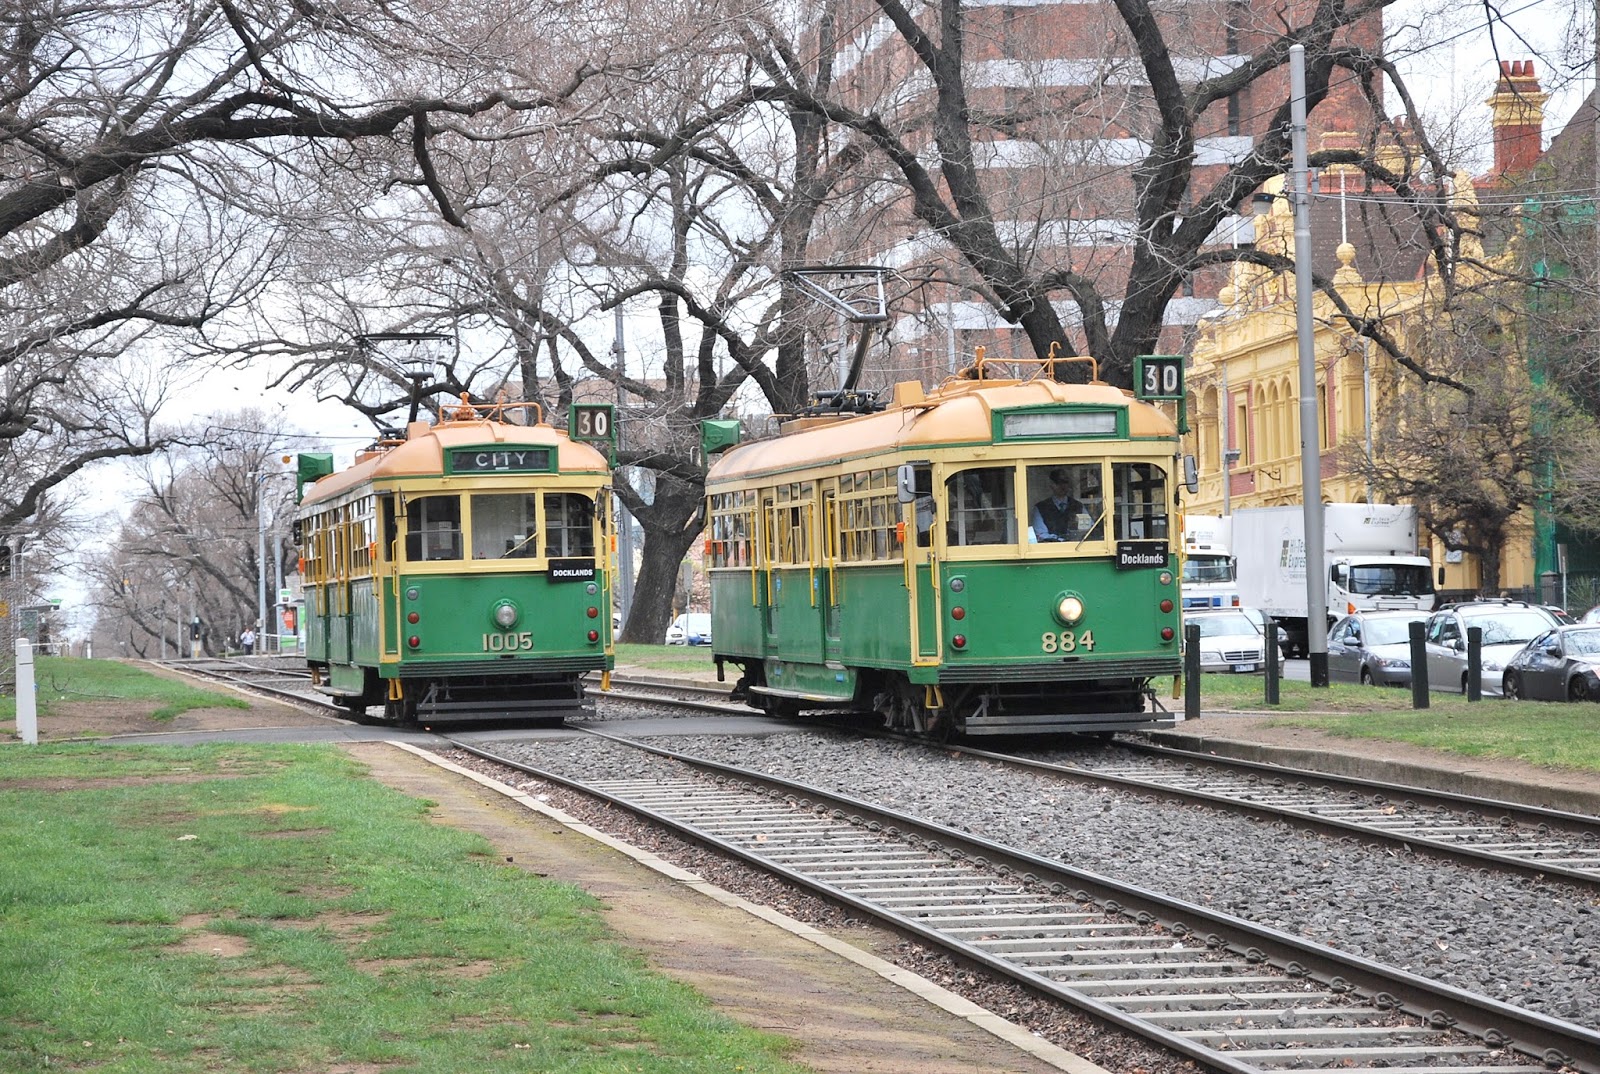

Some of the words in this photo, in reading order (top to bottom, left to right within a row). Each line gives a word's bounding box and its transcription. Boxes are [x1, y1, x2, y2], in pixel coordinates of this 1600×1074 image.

[1145, 365, 1178, 392] 30
[580, 411, 607, 436] 30
[475, 452, 527, 467] CITY
[1121, 553, 1164, 565] Docklands
[553, 569, 593, 577] DOCKLANDS
[482, 631, 533, 651] 1005
[1041, 630, 1096, 653] 884
